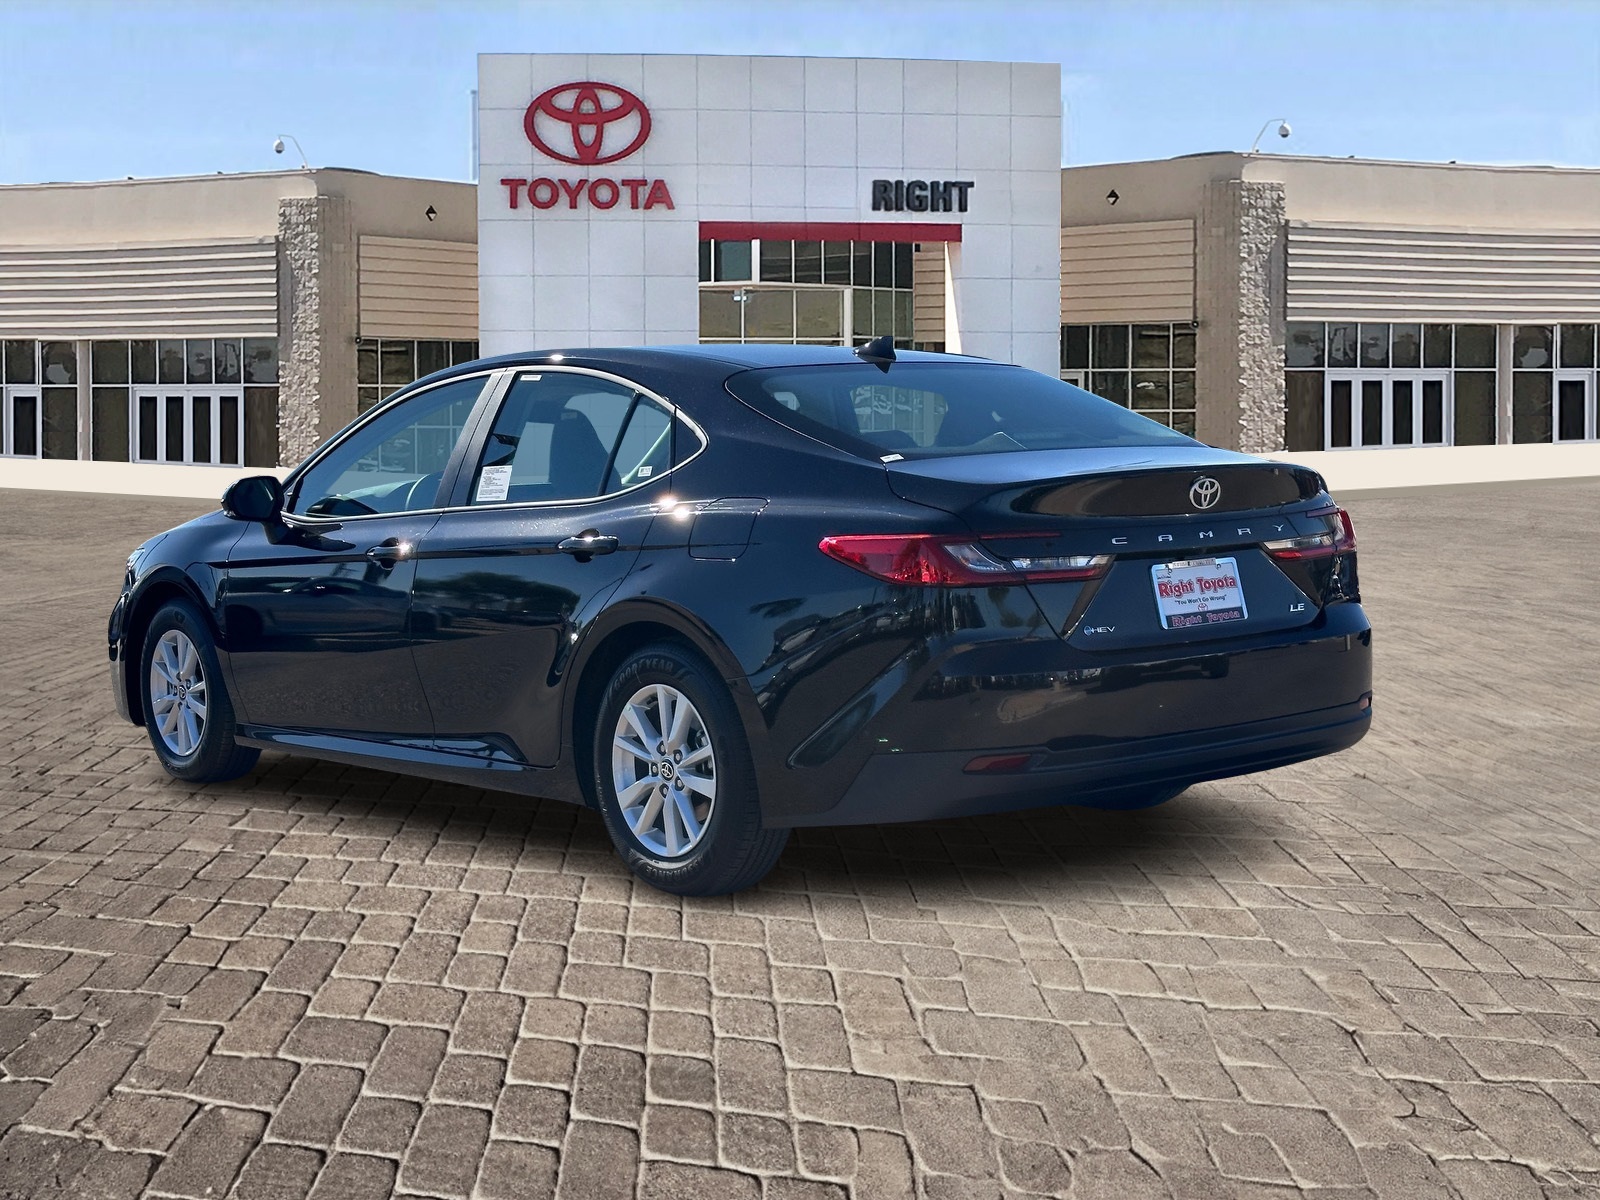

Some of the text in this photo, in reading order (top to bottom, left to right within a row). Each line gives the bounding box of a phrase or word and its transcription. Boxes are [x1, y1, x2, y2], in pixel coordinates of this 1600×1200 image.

[500, 178, 675, 210] TOYOTA
[870, 179, 975, 213] RIGHT
[1111, 524, 1285, 546] CAMRY
[1157, 575, 1237, 598] Right Toyota
[1172, 611, 1240, 626] Right Toyota
[1289, 603, 1305, 613] LE
